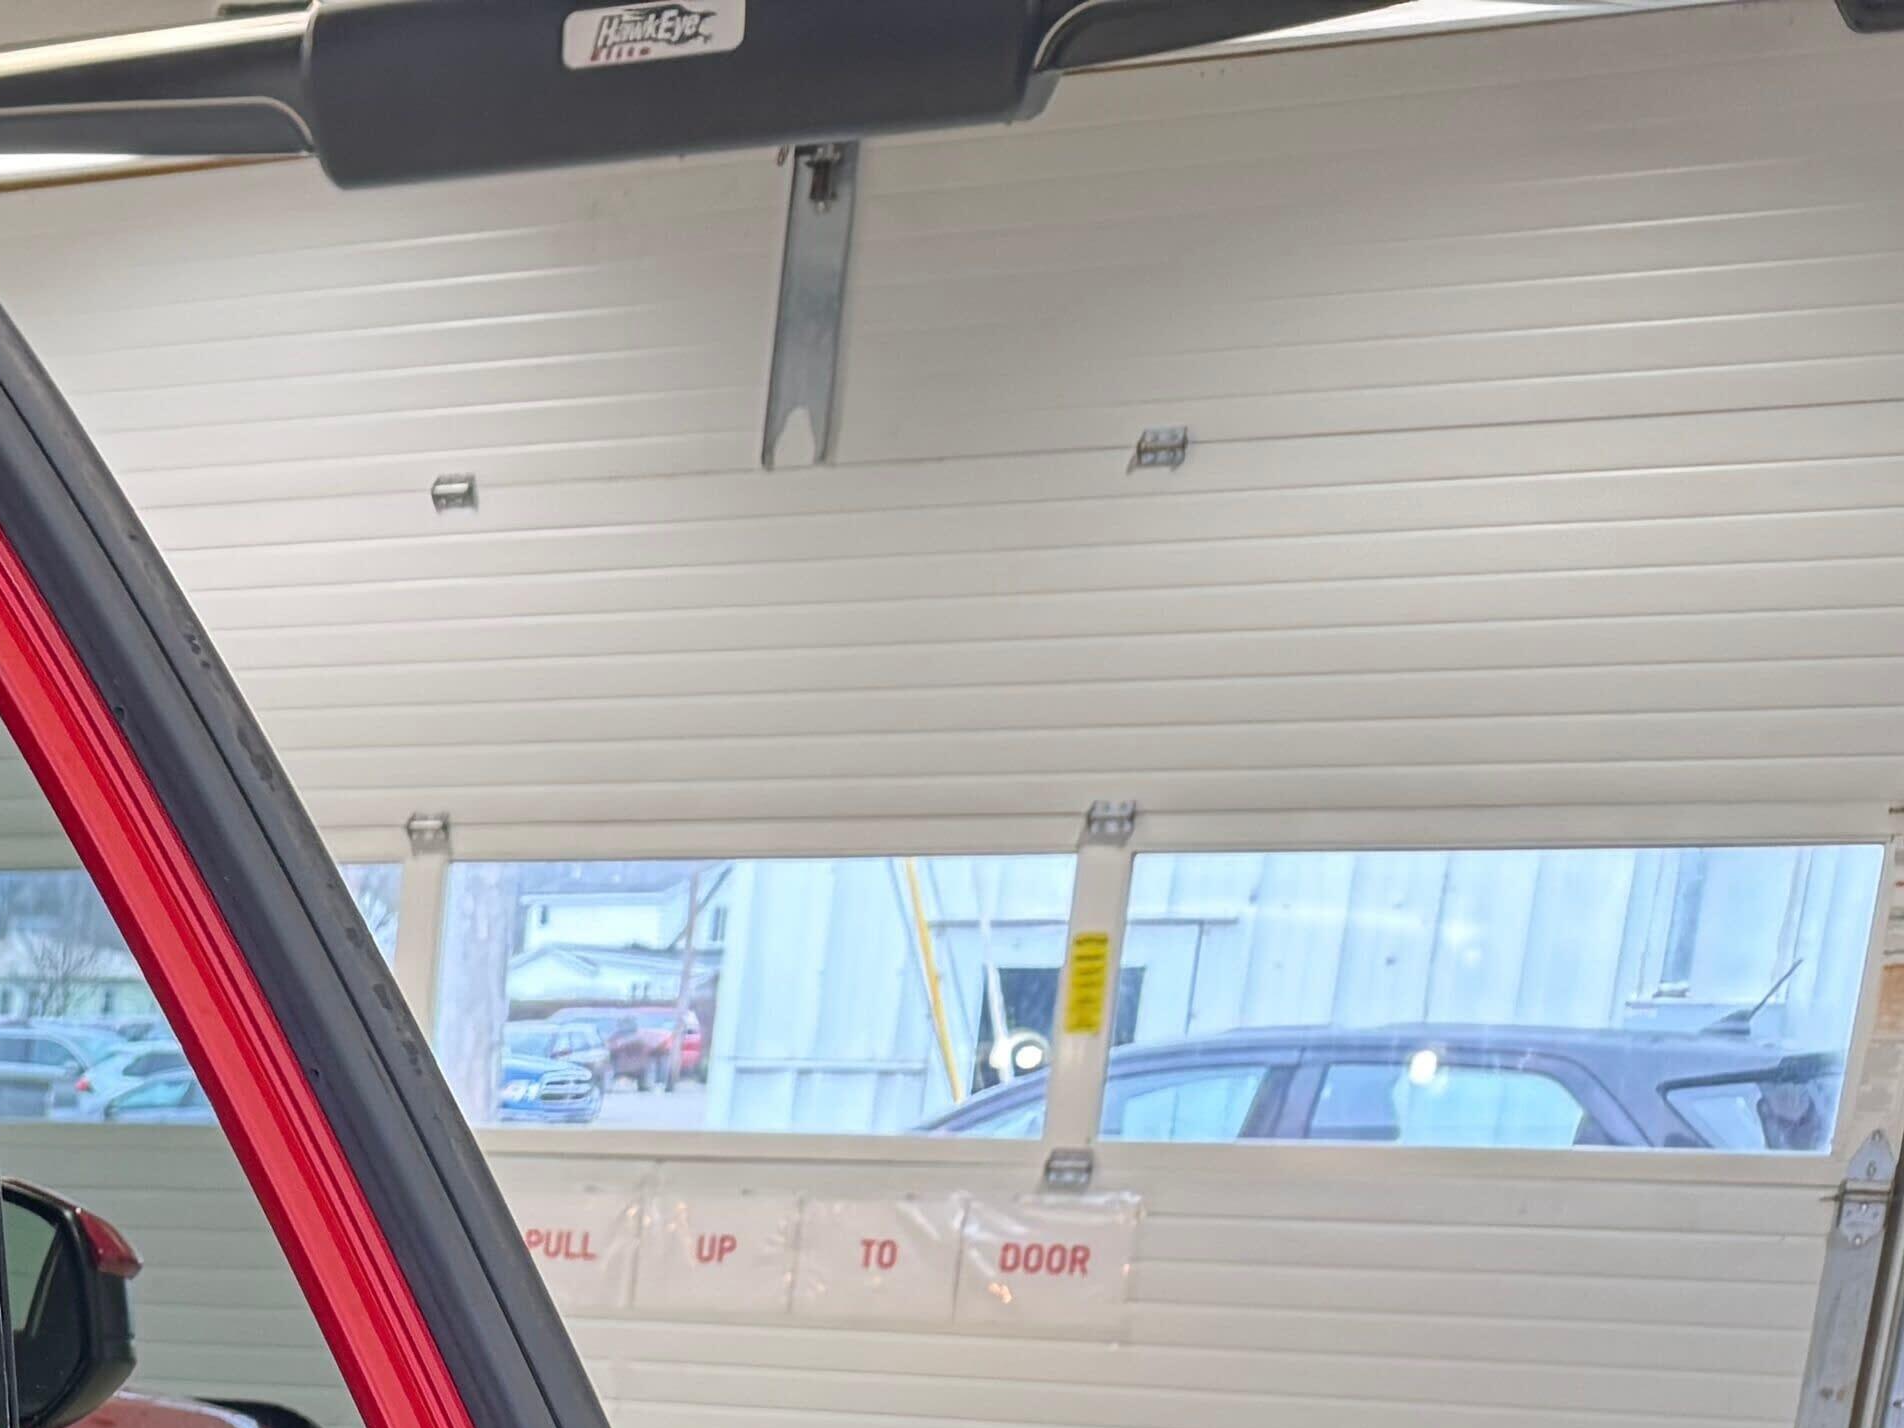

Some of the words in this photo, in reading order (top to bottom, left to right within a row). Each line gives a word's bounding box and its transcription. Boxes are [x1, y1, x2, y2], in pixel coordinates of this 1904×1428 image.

[526, 1229, 598, 1260] PULL
[698, 1233, 737, 1263] UP
[860, 1238, 899, 1269] TO
[999, 1242, 1091, 1276] DOOR
